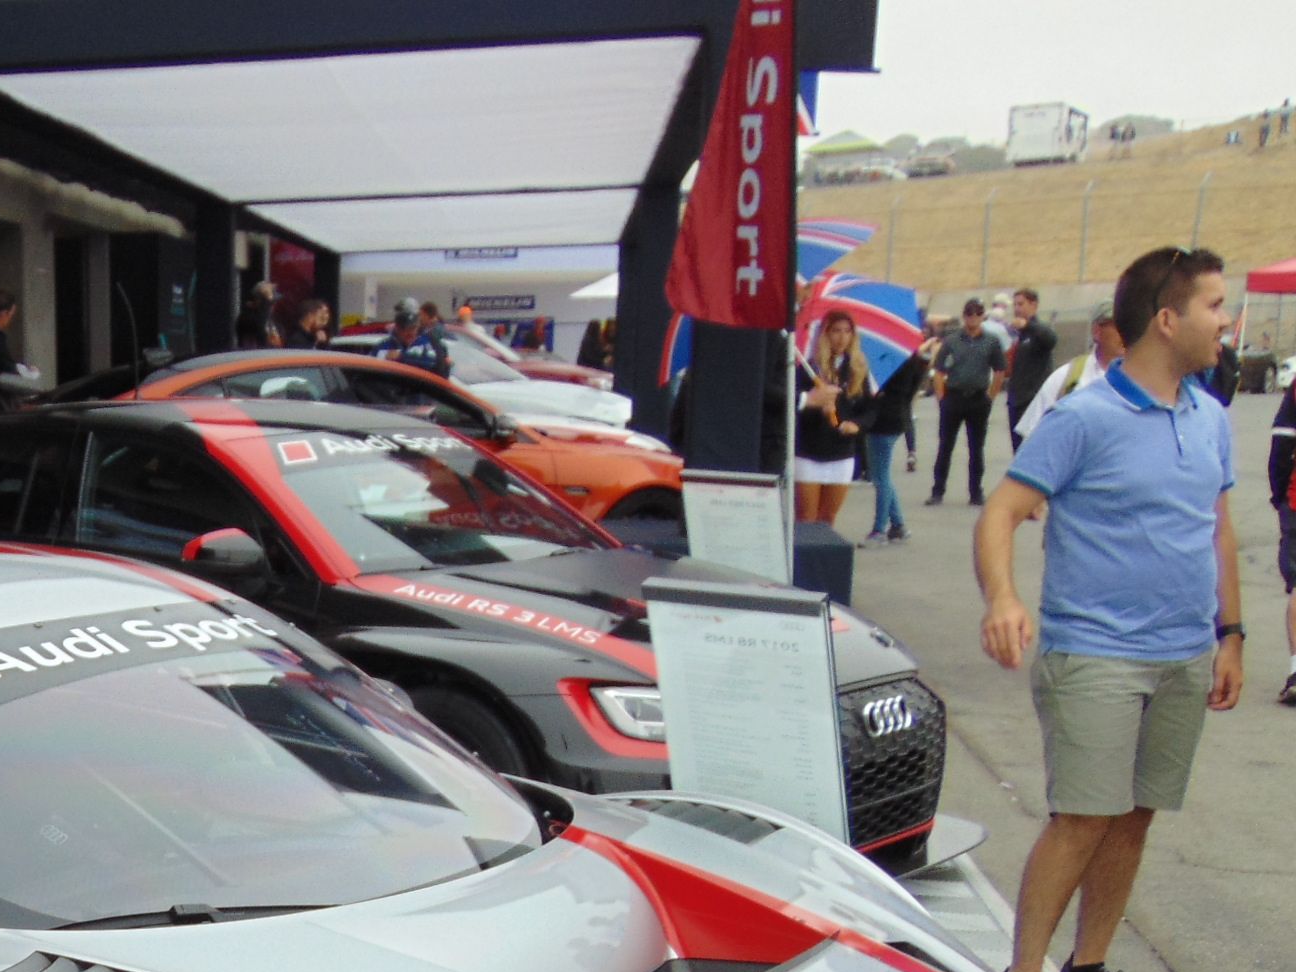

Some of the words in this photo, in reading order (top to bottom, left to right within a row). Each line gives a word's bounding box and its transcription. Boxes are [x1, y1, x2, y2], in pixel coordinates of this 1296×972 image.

[736, 56, 778, 297] Sport
[321, 434, 400, 455] Audi
[121, 613, 277, 651] Sport
[393, 584, 465, 605] Audi
[467, 598, 509, 616] RS
[537, 617, 603, 644] LMS
